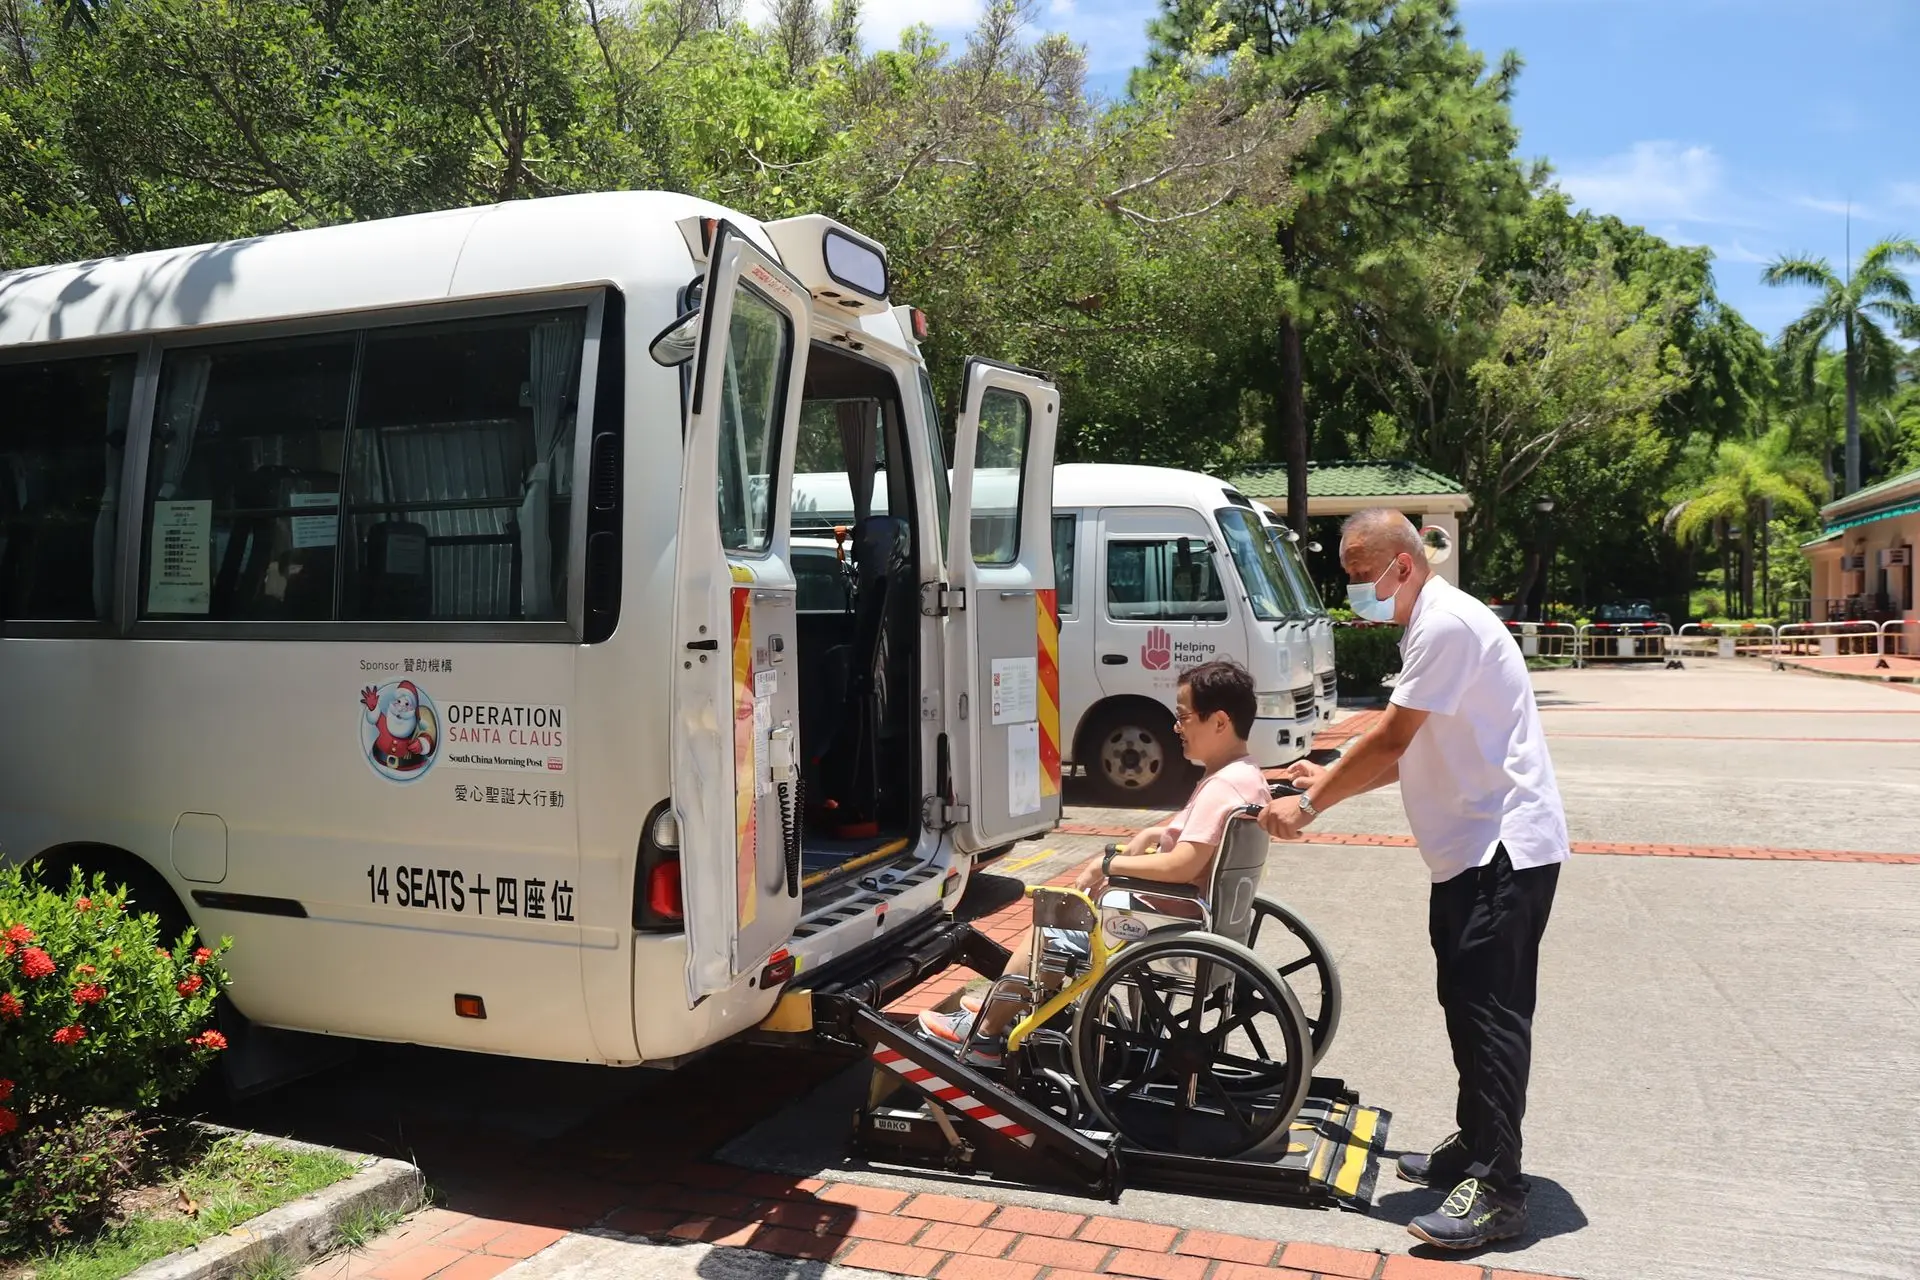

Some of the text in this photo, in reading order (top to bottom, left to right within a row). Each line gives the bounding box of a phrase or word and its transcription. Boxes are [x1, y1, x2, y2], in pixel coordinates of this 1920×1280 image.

[1174, 642, 1216, 654] Helping
[1174, 653, 1203, 662] Hand
[360, 658, 453, 673] Sponsor 贊助機構
[448, 705, 562, 728] OPERATION
[449, 727, 563, 747] SANTA CLAUS
[448, 754, 470, 764] South
[470, 755, 493, 765] China
[493, 757, 526, 768] Morning
[526, 759, 543, 768] Post
[454, 784, 565, 809] 愛心聖誕大行動
[367, 864, 575, 922] 14 SEATS 十四座位
[879, 1120, 906, 1130] WAKO
